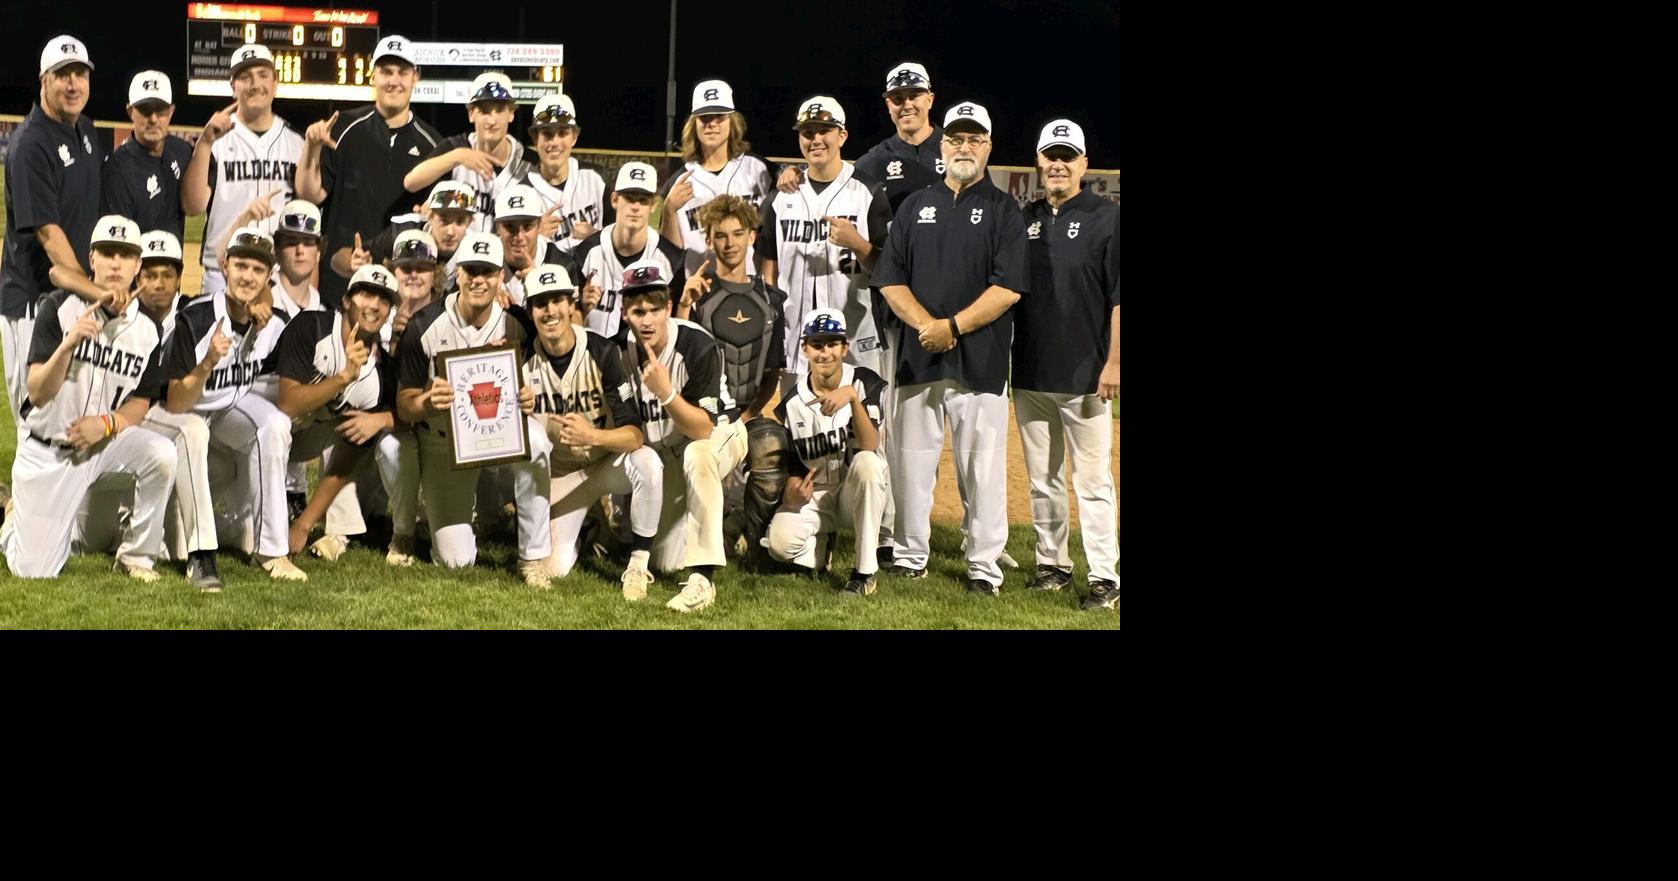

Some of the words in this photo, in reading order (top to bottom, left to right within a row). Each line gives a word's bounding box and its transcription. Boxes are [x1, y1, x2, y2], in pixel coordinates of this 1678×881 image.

[223, 159, 297, 182] WILDCAT
[74, 336, 144, 379] ILDCATS
[456, 362, 511, 393] HERITAGE
[456, 397, 514, 435] CONFERENCE
[469, 393, 503, 408] Athletics
